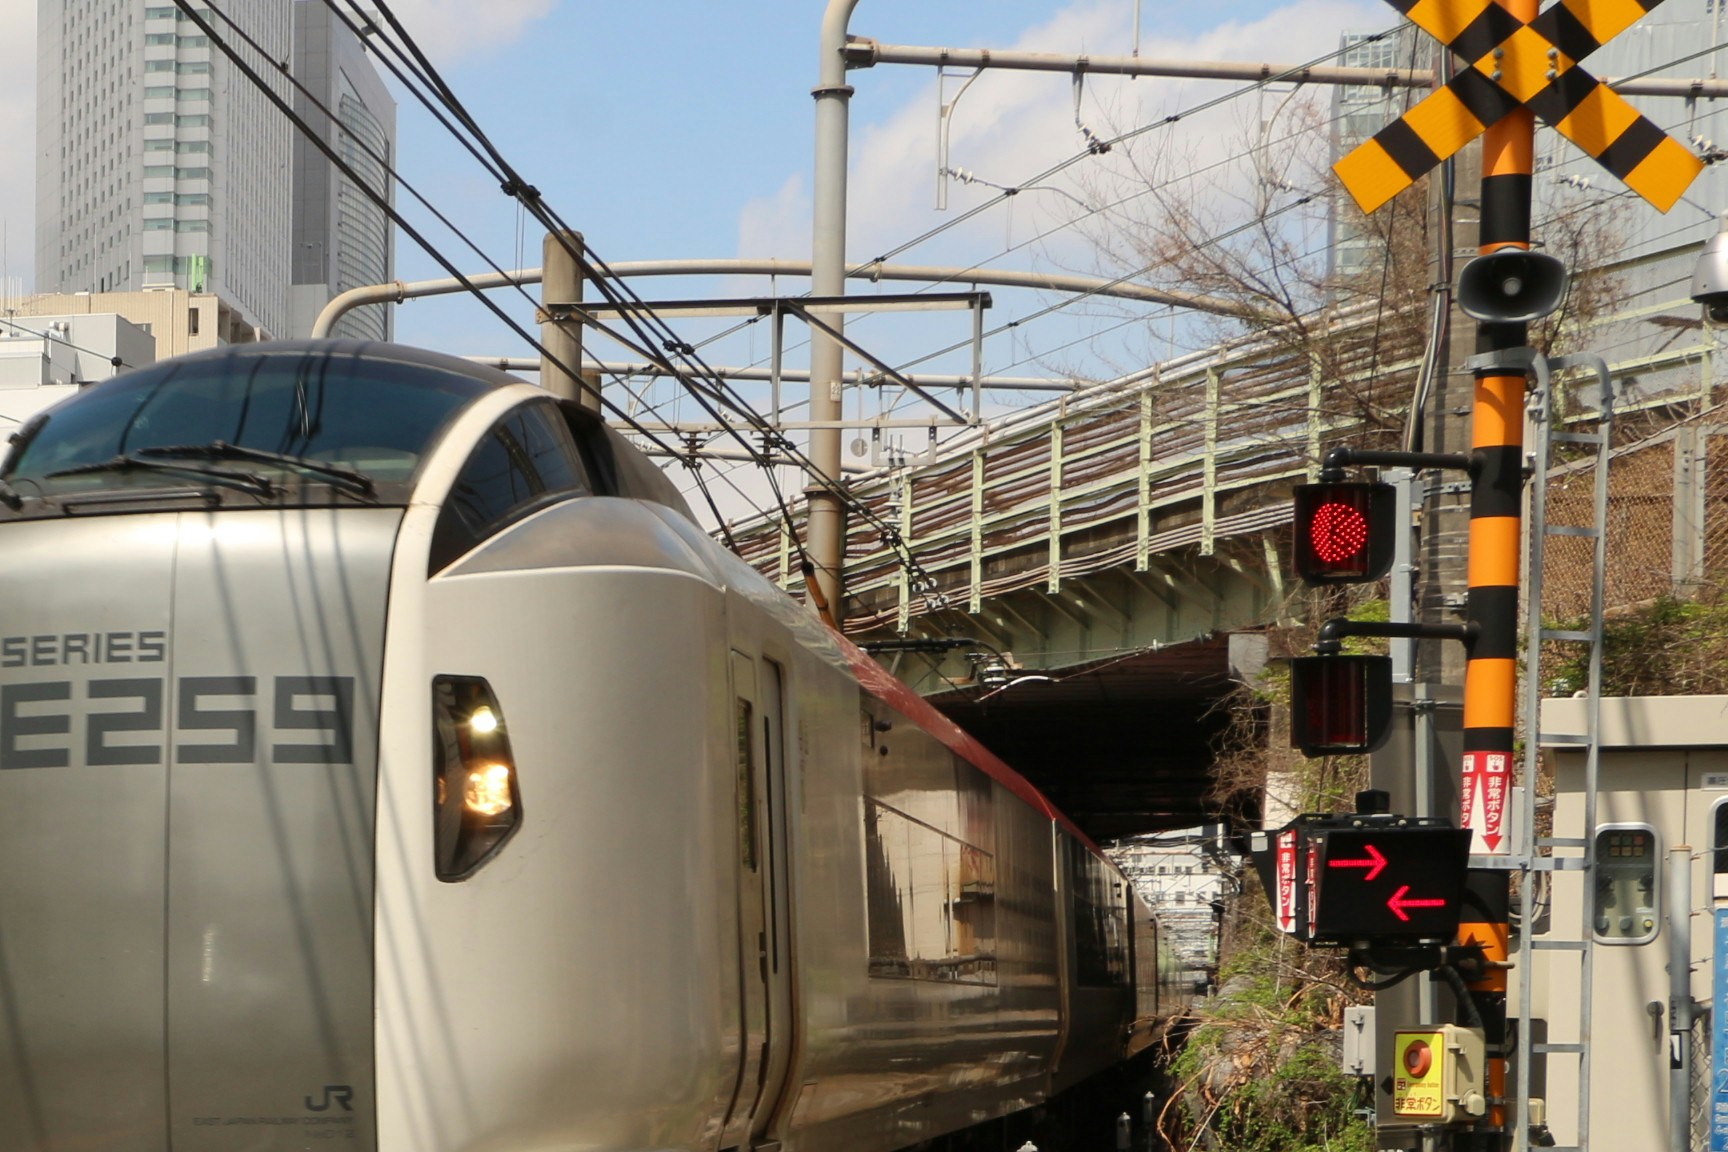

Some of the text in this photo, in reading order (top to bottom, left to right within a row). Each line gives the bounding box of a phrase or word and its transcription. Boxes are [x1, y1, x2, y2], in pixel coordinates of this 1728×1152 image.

[0, 631, 166, 668] SERIES
[1486, 776, 1502, 835] 非常ボタン
[305, 1085, 354, 1112] JR
[1395, 1096, 1441, 1111] 非常ボタン
